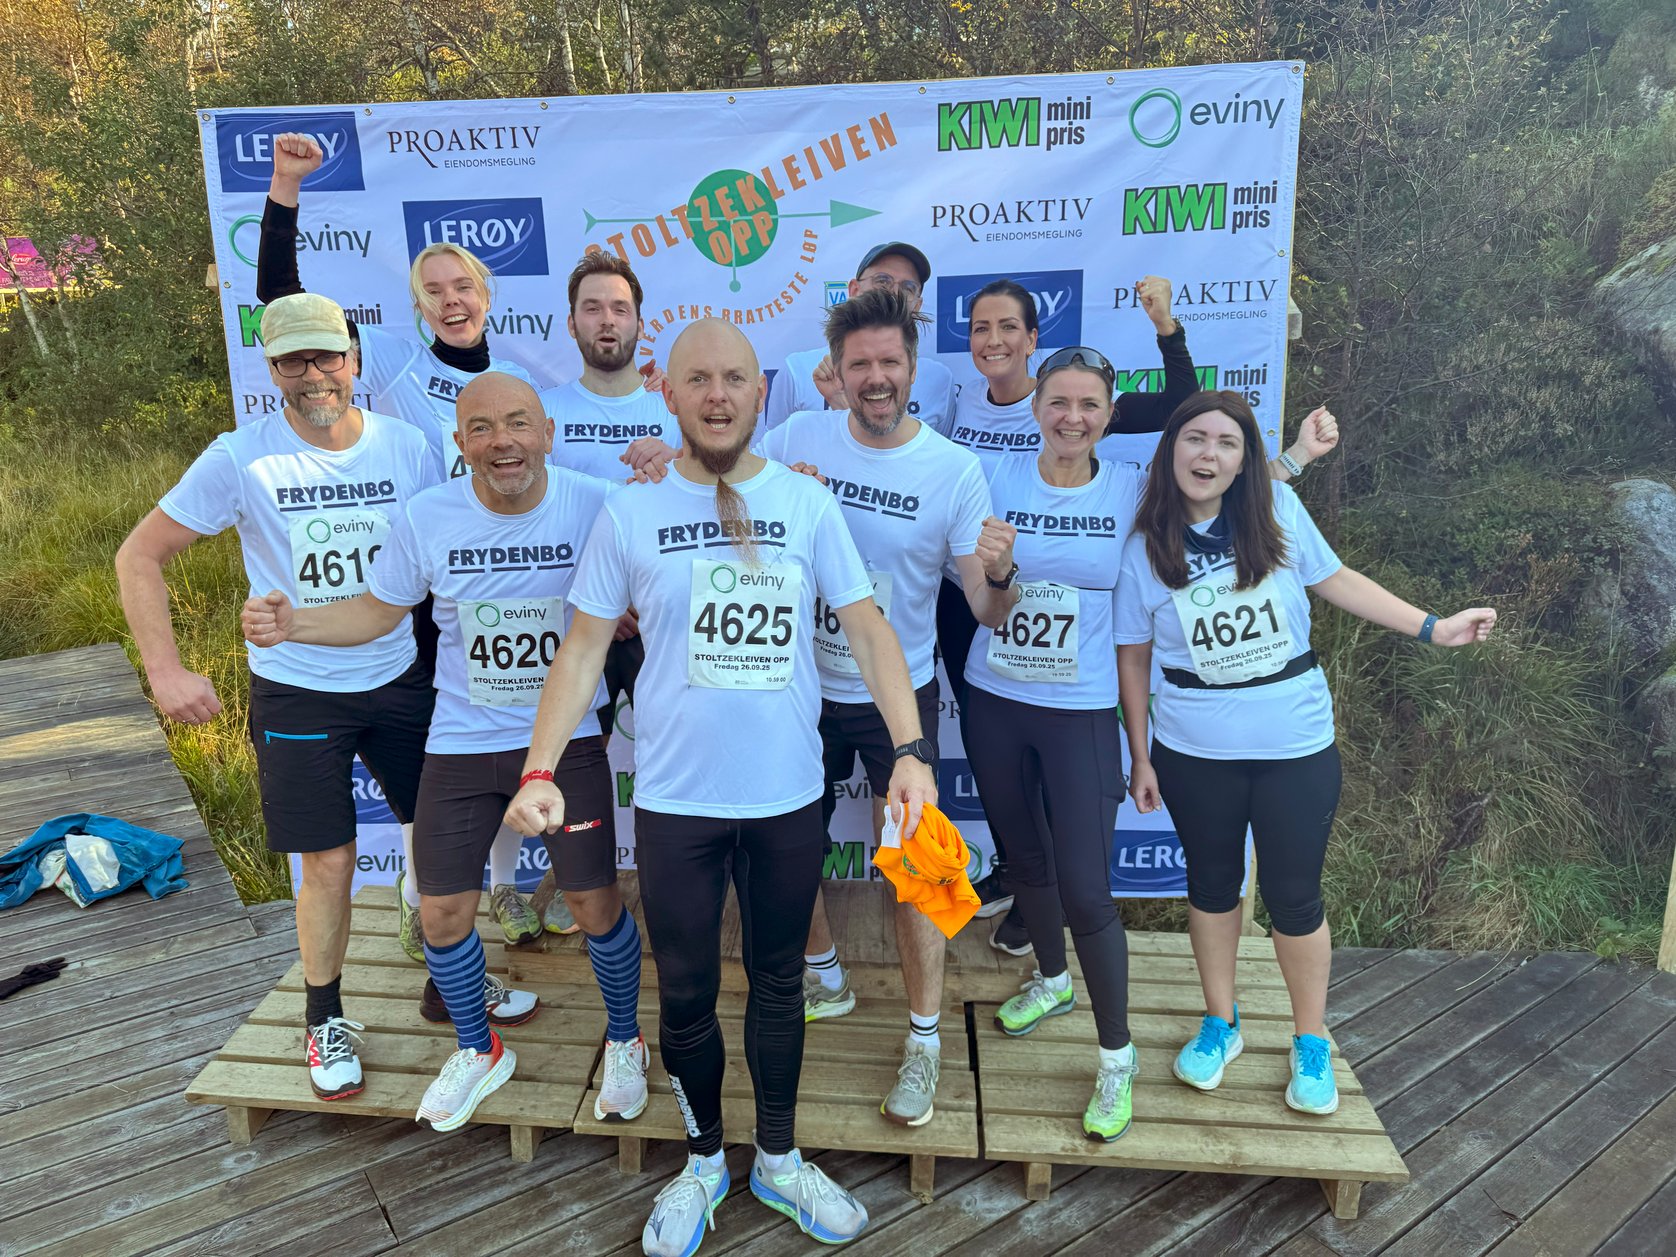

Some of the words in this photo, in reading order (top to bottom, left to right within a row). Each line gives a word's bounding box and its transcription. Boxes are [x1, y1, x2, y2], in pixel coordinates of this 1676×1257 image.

[1046, 96, 1092, 121] mini
[1189, 93, 1285, 129] eviny
[937, 97, 1041, 151] KIWI
[1046, 121, 1085, 151] pris
[235, 133, 340, 162] LEY
[387, 126, 542, 168] PROAKTIV
[444, 157, 536, 169] EIENDOMSMEGLING
[1233, 180, 1278, 205] mini
[930, 197, 1093, 242] PROAKTIV
[1122, 182, 1228, 235] KIWI
[1232, 206, 1271, 234] pris
[424, 218, 526, 248] LERØY
[708, 211, 774, 265] OPP
[986, 229, 1083, 242] EIENDOMSMEGLING
[639, 305, 712, 356] VERDENS
[800, 228, 819, 264] LØP
[1112, 279, 1279, 309] PAKTIV
[1224, 363, 1267, 387] mini
[564, 423, 663, 438] FRYDENBØ
[953, 426, 1041, 448] FRYDENBØ
[276, 478, 395, 505] FRYDENBØ
[825, 477, 919, 512] YDENBØ
[333, 519, 375, 534] eviny
[1005, 511, 1116, 532] FRYDENBØ
[448, 542, 574, 567] FRYDENBØ
[740, 572, 785, 590] eviny
[1025, 587, 1064, 601] eviny
[503, 606, 547, 620] eviny
[694, 602, 793, 646] 4625
[1192, 598, 1279, 651] 4621
[994, 612, 1075, 648] 4627
[470, 631, 561, 670] 4620
[694, 653, 772, 663] STOLTZEKLEIVEN
[773, 656, 790, 664] OPP
[992, 652, 1055, 663] STOLTZEKLEIVEN
[1200, 645, 1271, 668] STOLTZEKLEIVEN
[1272, 640, 1289, 649] OPP
[714, 663, 739, 671] Fredag
[1220, 661, 1244, 671] Fredag
[473, 676, 545, 685] STOLTZEKLEIVEN
